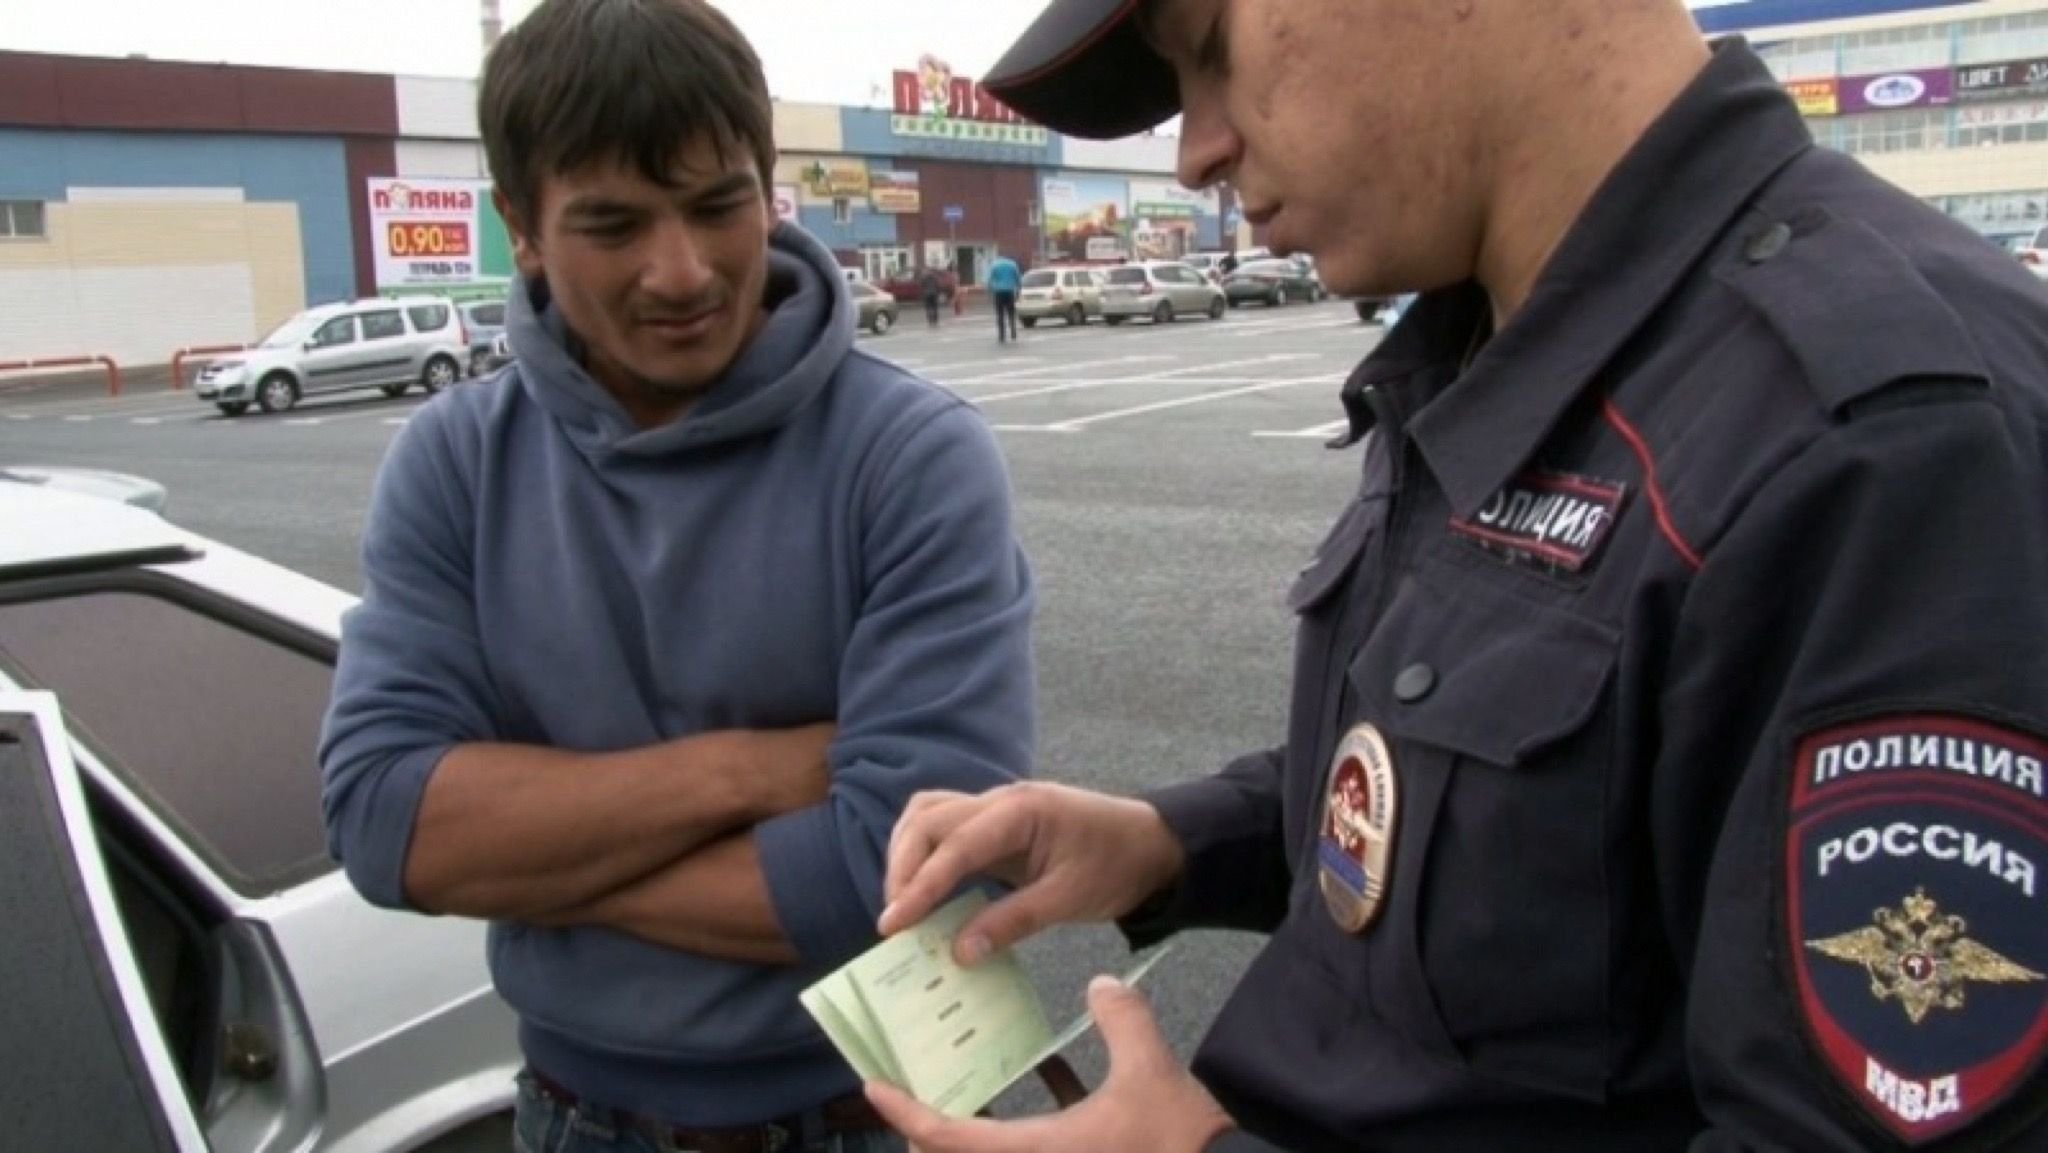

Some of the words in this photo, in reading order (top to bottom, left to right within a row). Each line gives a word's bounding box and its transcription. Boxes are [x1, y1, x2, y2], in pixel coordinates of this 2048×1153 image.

[393, 227, 443, 256] 0,90
[1814, 735, 2043, 796] ПОЛИЦИЯ
[1817, 822, 2036, 898] РОССИЯ
[1866, 1055, 1960, 1122] МВД
